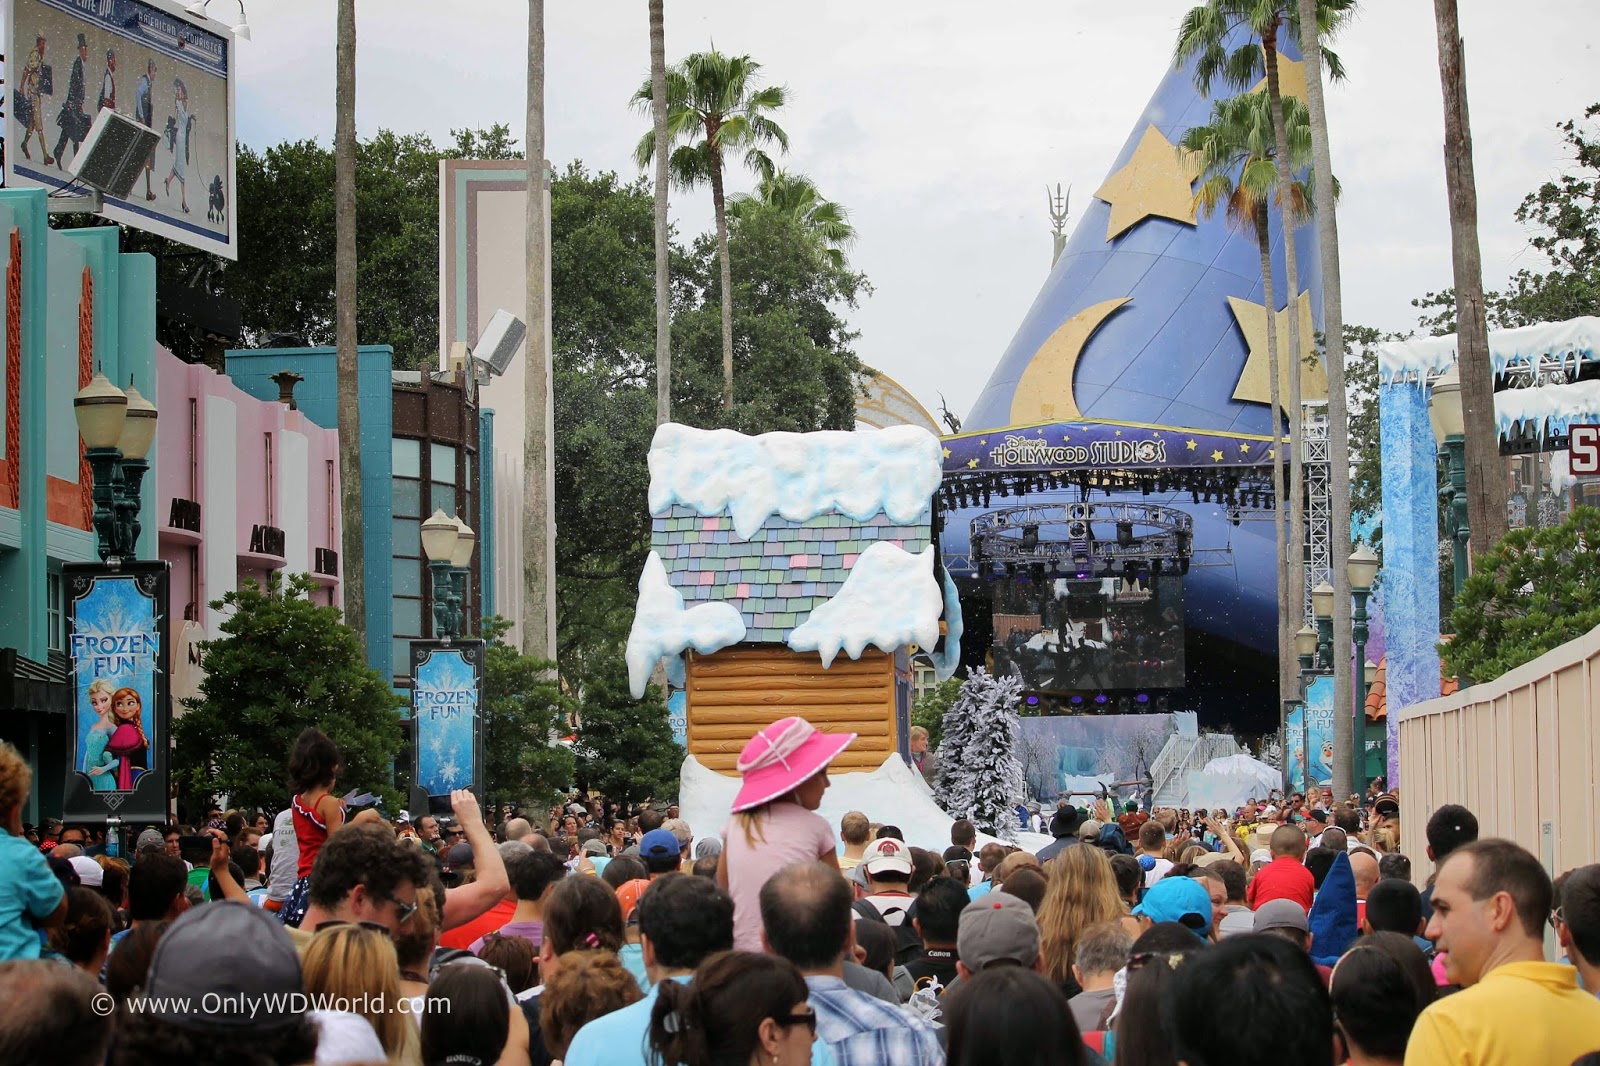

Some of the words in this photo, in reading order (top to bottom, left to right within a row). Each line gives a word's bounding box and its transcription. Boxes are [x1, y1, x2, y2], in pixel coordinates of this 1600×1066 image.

[138, 11, 177, 36] AMERICAN
[186, 31, 222, 56] TOURISTER
[1572, 427, 1600, 472] S
[69, 631, 161, 658] FROZEN
[93, 655, 136, 678] FUN
[413, 688, 479, 708] FROZEN
[430, 705, 461, 721] FUN
[1305, 708, 1334, 720] FROZ
[673, 728, 687, 737] FU
[1316, 720, 1334, 729] FU
[928, 950, 951, 958] Canon
